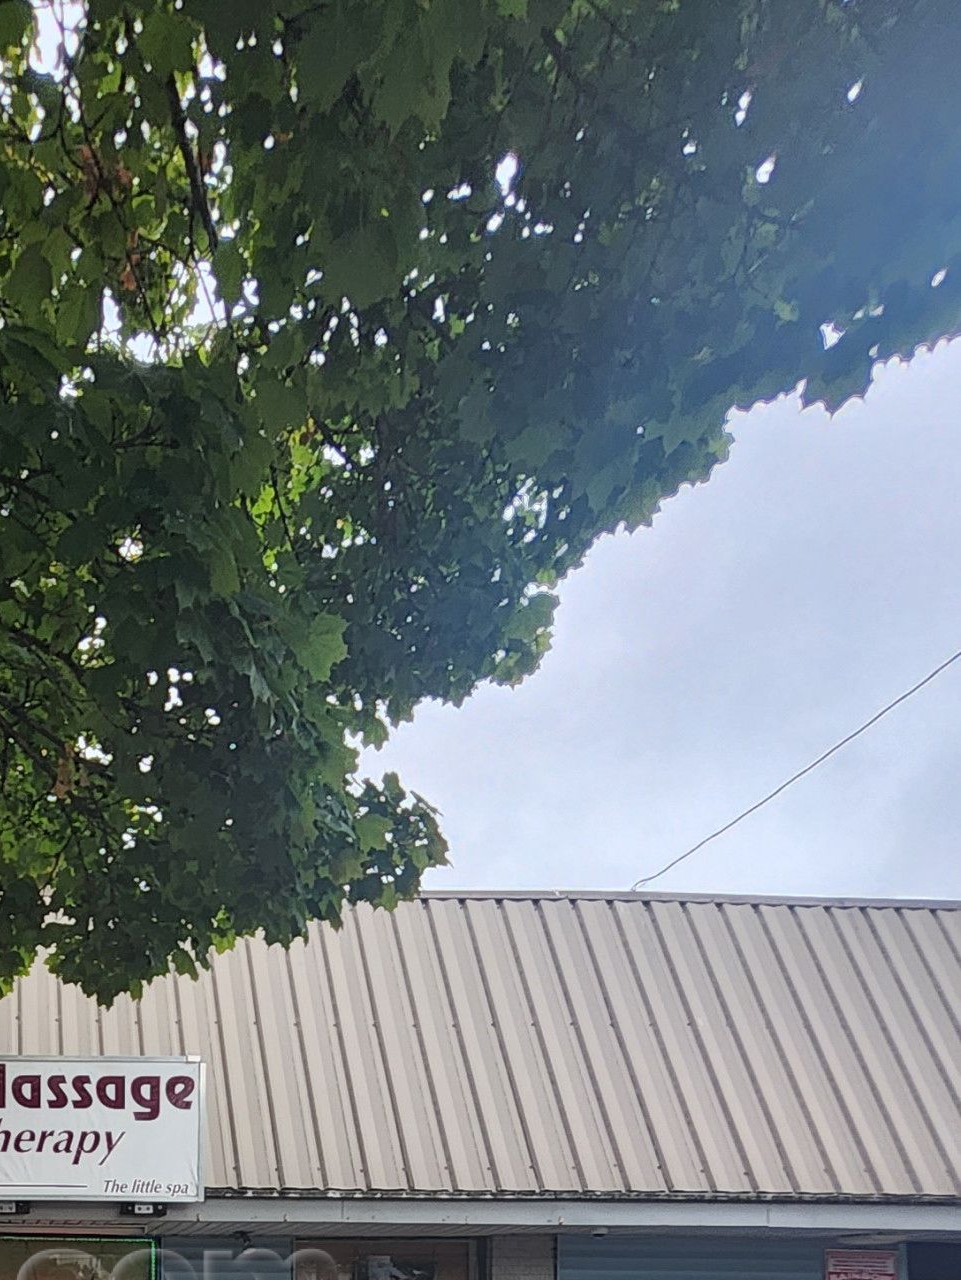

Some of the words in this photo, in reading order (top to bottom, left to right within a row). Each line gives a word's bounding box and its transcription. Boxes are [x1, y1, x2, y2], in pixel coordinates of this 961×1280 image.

[104, 1179, 128, 1193] The
[131, 1179, 162, 1193] little
[165, 1183, 189, 1197] spa
